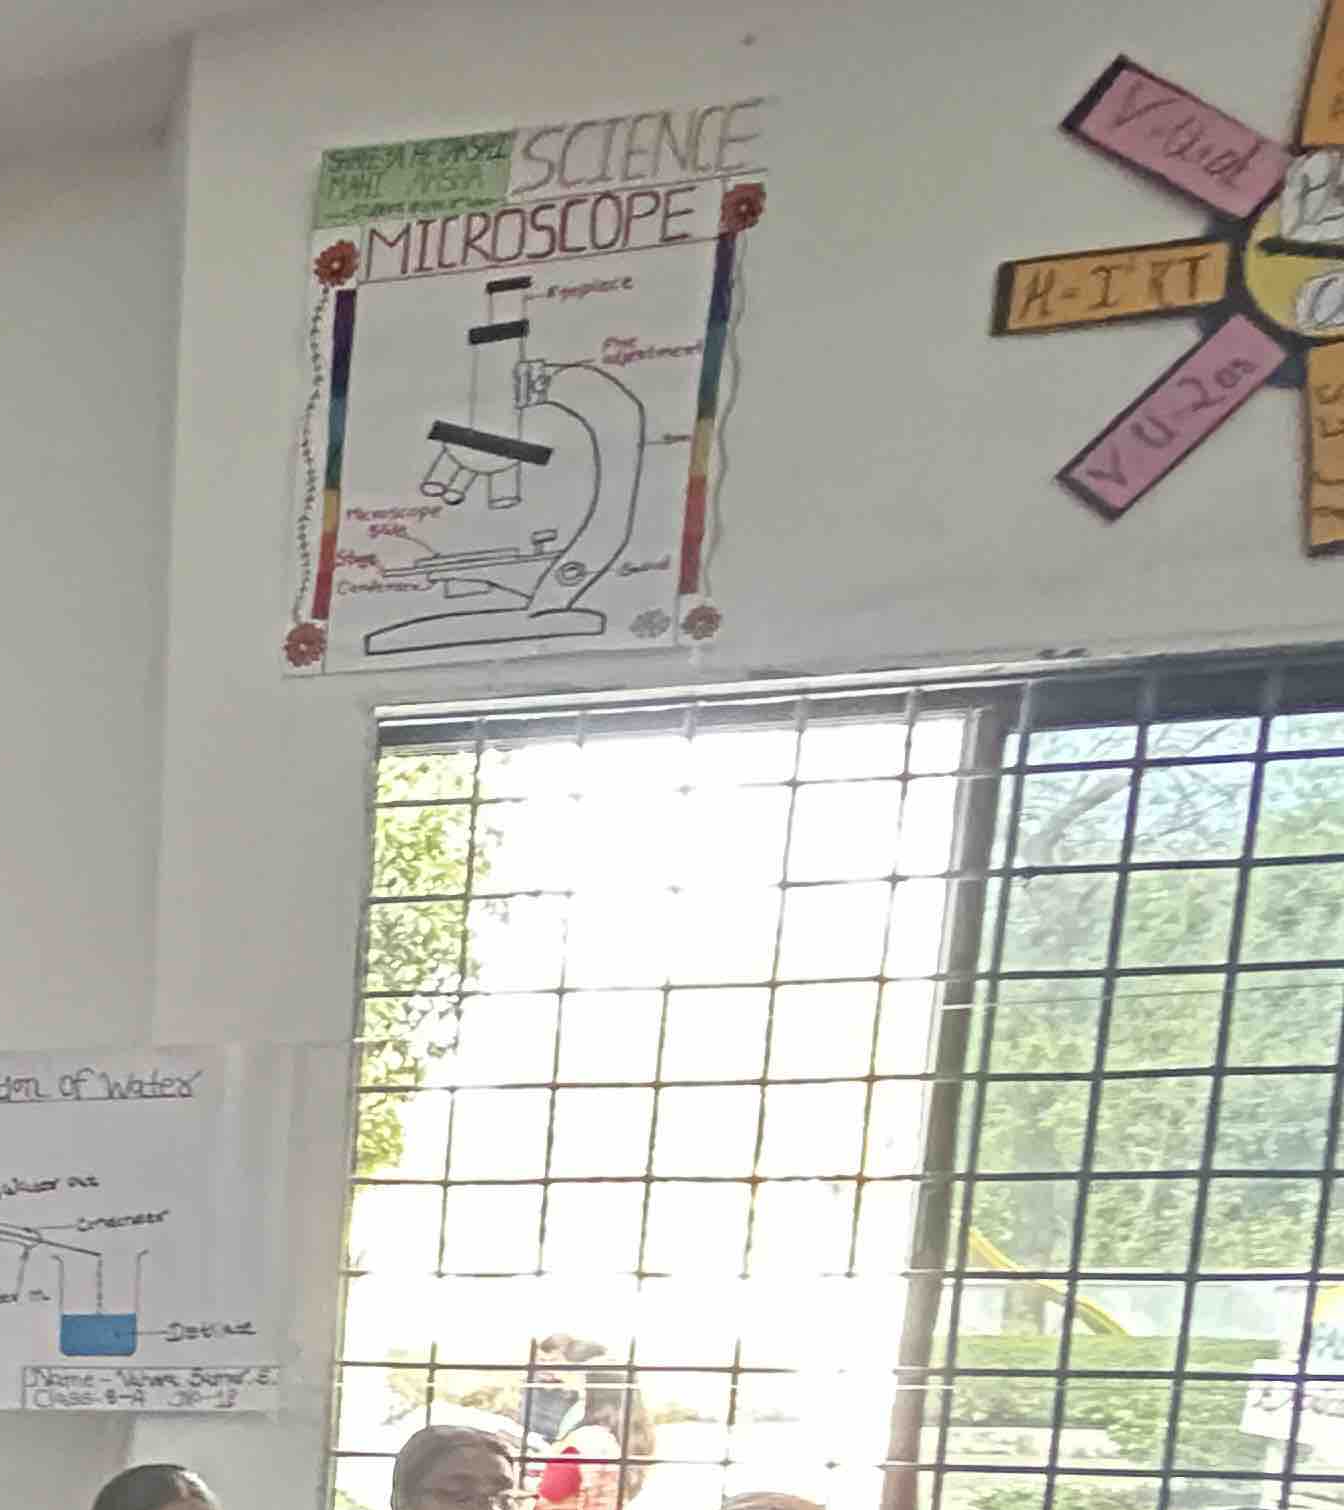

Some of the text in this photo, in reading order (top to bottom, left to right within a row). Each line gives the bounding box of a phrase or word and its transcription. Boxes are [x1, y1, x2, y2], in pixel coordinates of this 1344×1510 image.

[511, 97, 766, 197] SCIENCE
[365, 186, 698, 280] MICROSCOPE
[57, 1066, 97, 1099] of
